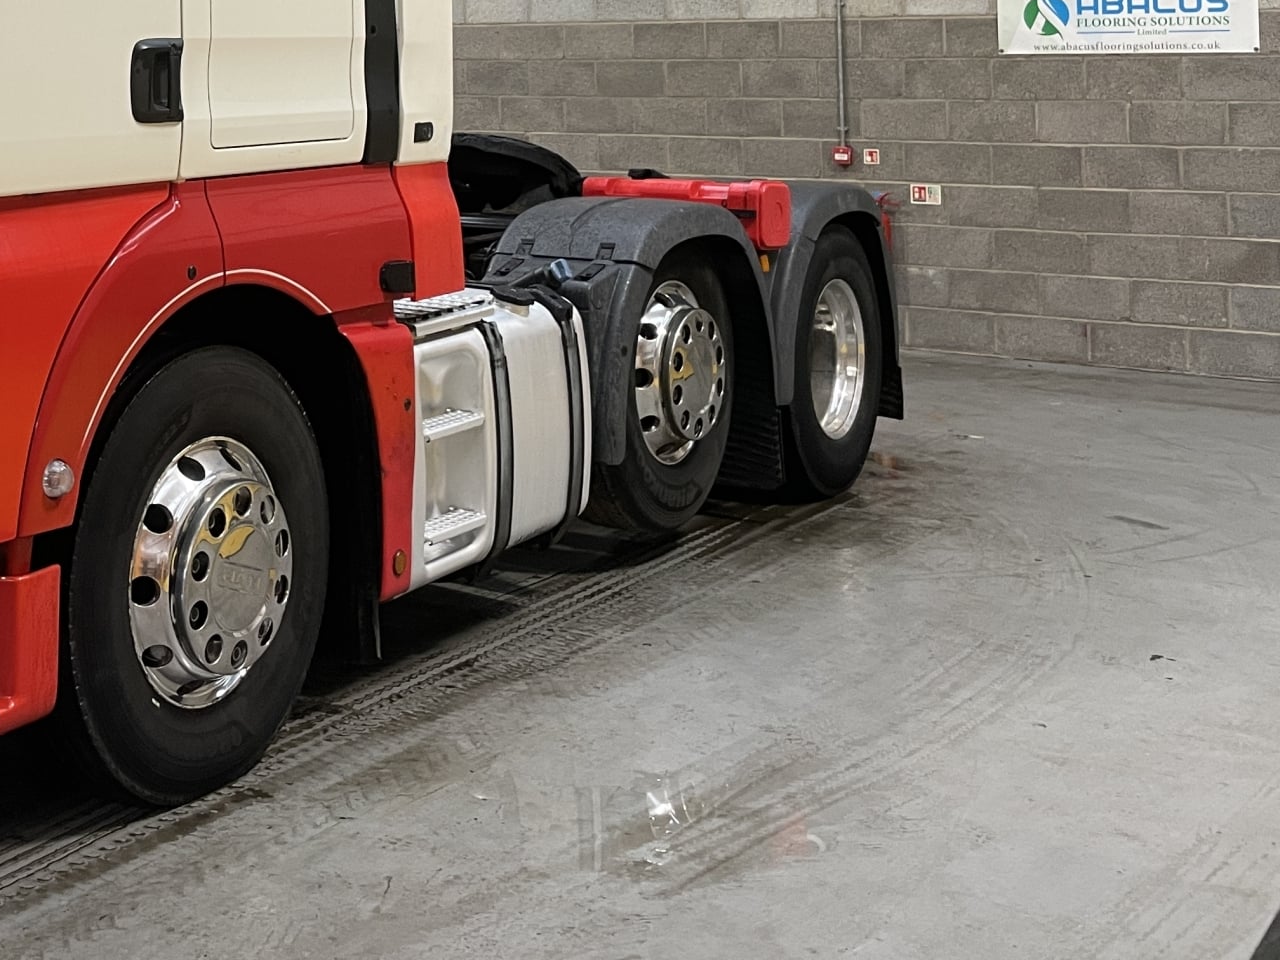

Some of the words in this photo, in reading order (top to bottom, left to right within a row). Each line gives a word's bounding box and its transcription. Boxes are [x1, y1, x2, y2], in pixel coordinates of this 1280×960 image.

[1076, 16, 1147, 28] FLOORING
[1150, 15, 1230, 26] SOLUTIONS
[1137, 28, 1168, 36] Limited
[1033, 40, 1221, 52] www.abacusflooringsolutions.co.uk
